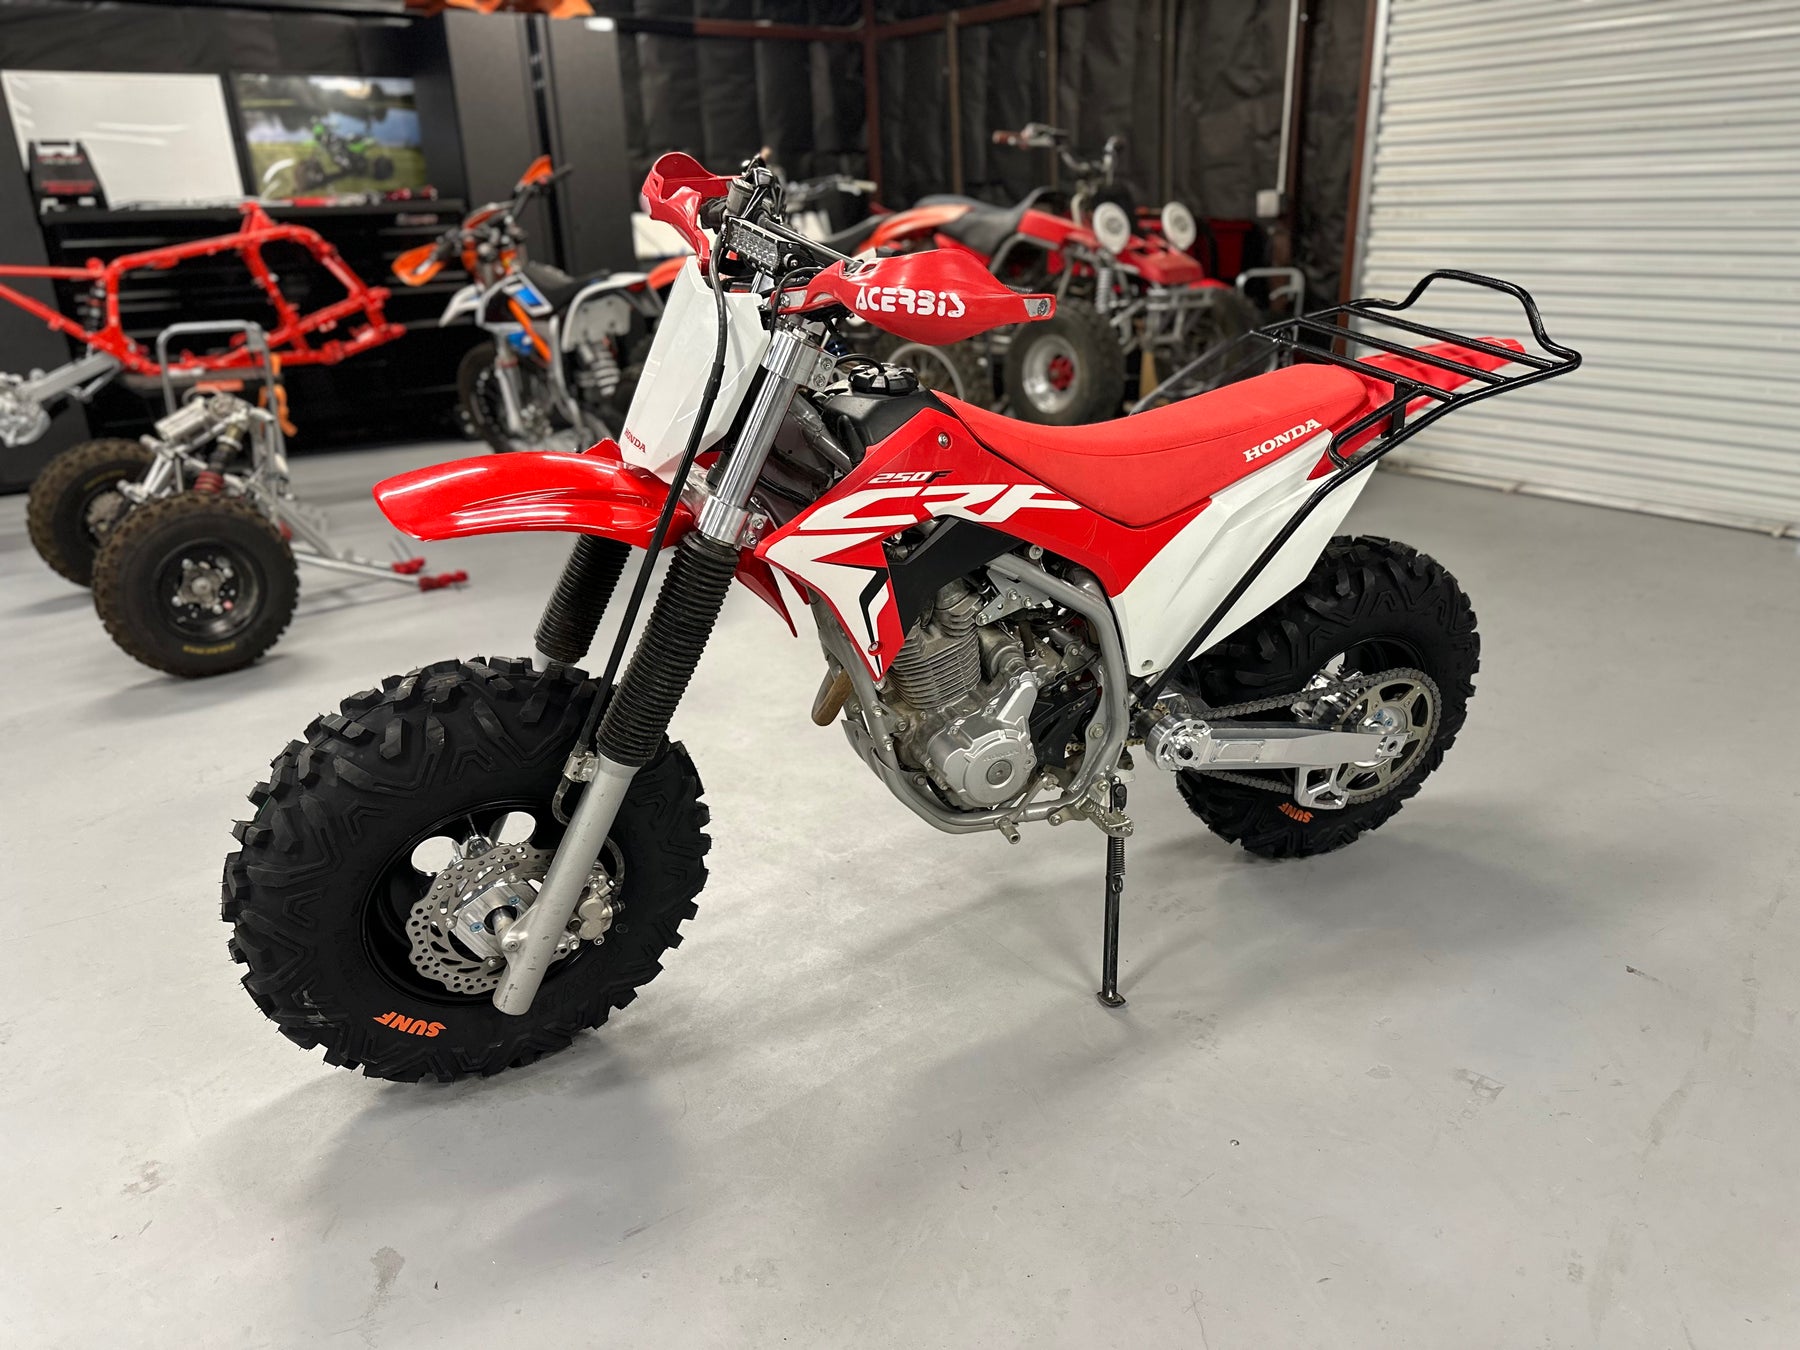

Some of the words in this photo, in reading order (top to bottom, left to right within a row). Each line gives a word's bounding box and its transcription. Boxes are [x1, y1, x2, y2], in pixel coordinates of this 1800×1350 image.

[1242, 418, 1323, 463] HONDA
[867, 470, 953, 484] 250F
[799, 484, 1082, 531] CRF
[1278, 802, 1314, 824] SUNF
[372, 1011, 447, 1038] SUNF
